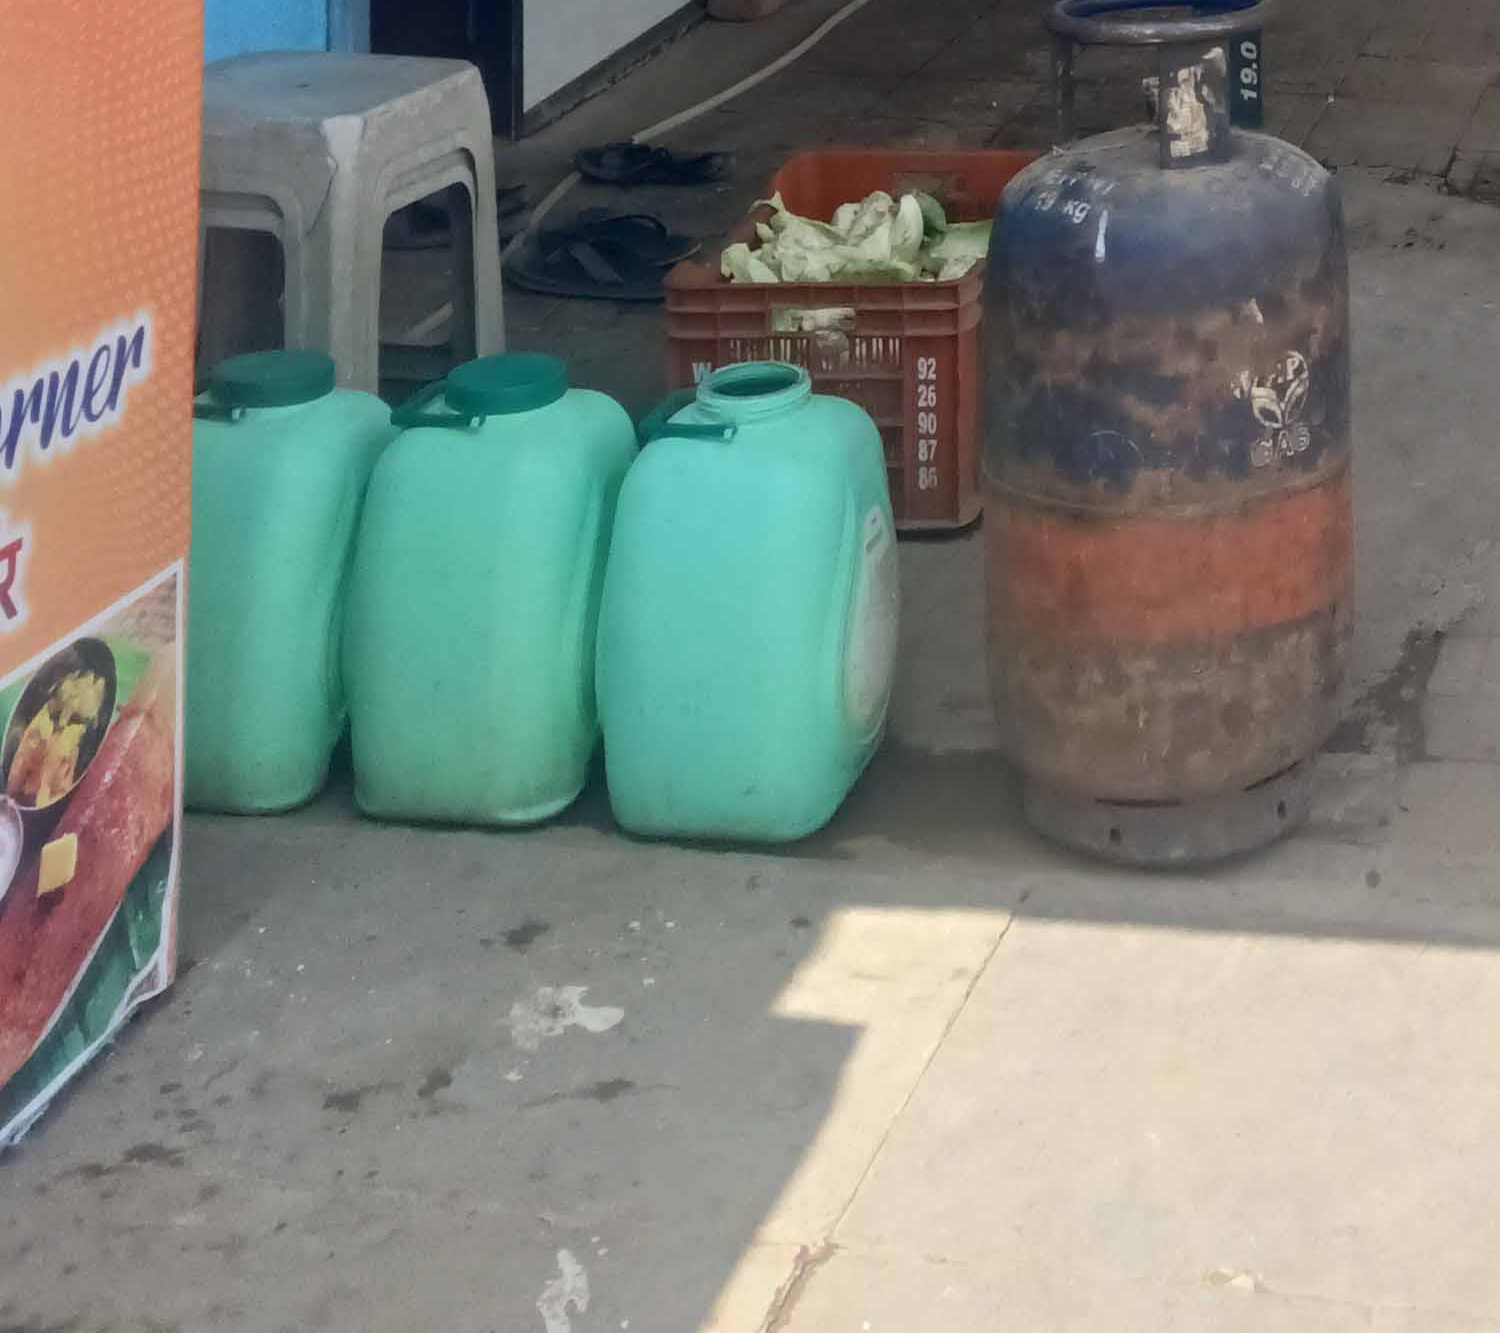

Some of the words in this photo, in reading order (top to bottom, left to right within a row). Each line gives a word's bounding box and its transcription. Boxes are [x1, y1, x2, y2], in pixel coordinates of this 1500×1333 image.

[1240, 40, 1258, 101] 19.0
[917, 356, 937, 381] 92
[0, 324, 145, 470] rner
[917, 384, 937, 408] 26
[917, 411, 937, 435] 90
[918, 439, 937, 462] 87
